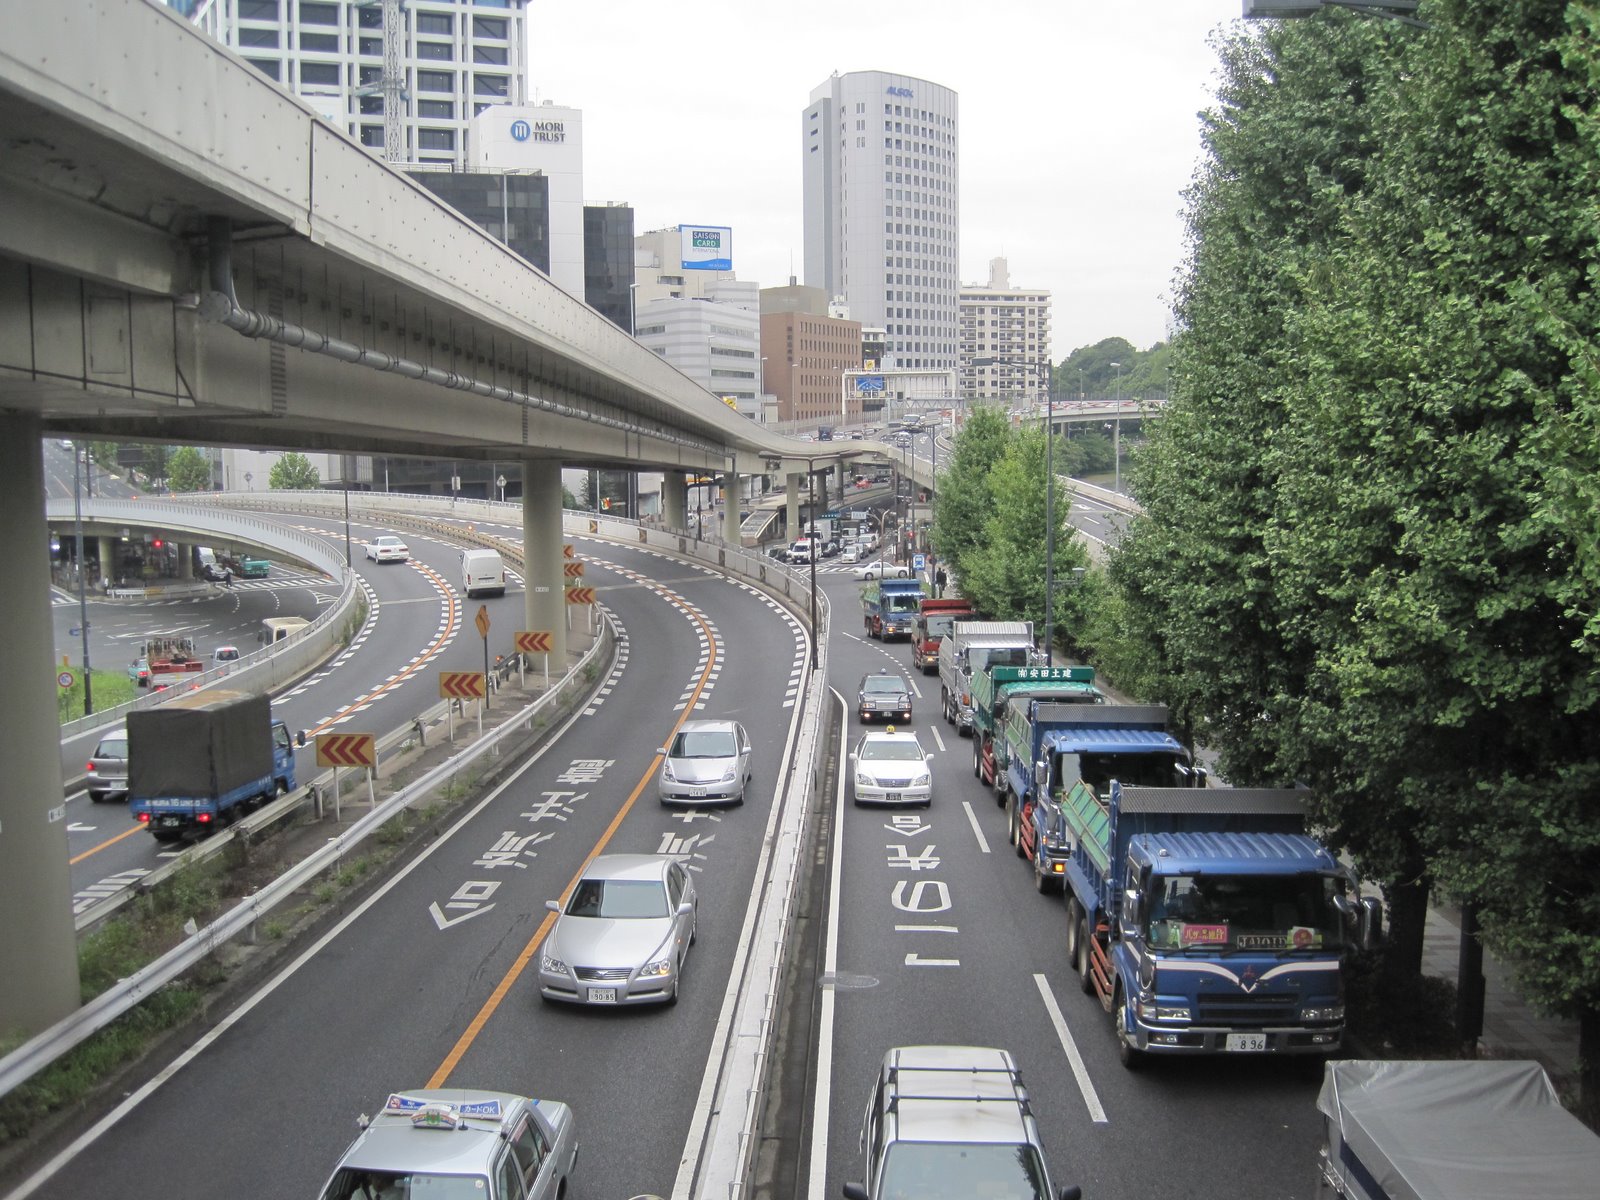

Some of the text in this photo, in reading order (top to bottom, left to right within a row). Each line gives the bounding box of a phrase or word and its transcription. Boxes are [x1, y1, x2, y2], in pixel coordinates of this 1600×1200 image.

[534, 121, 564, 132] MORI
[532, 132, 566, 142] TRUST
[693, 231, 720, 240] SAISON
[696, 239, 716, 247] CARD
